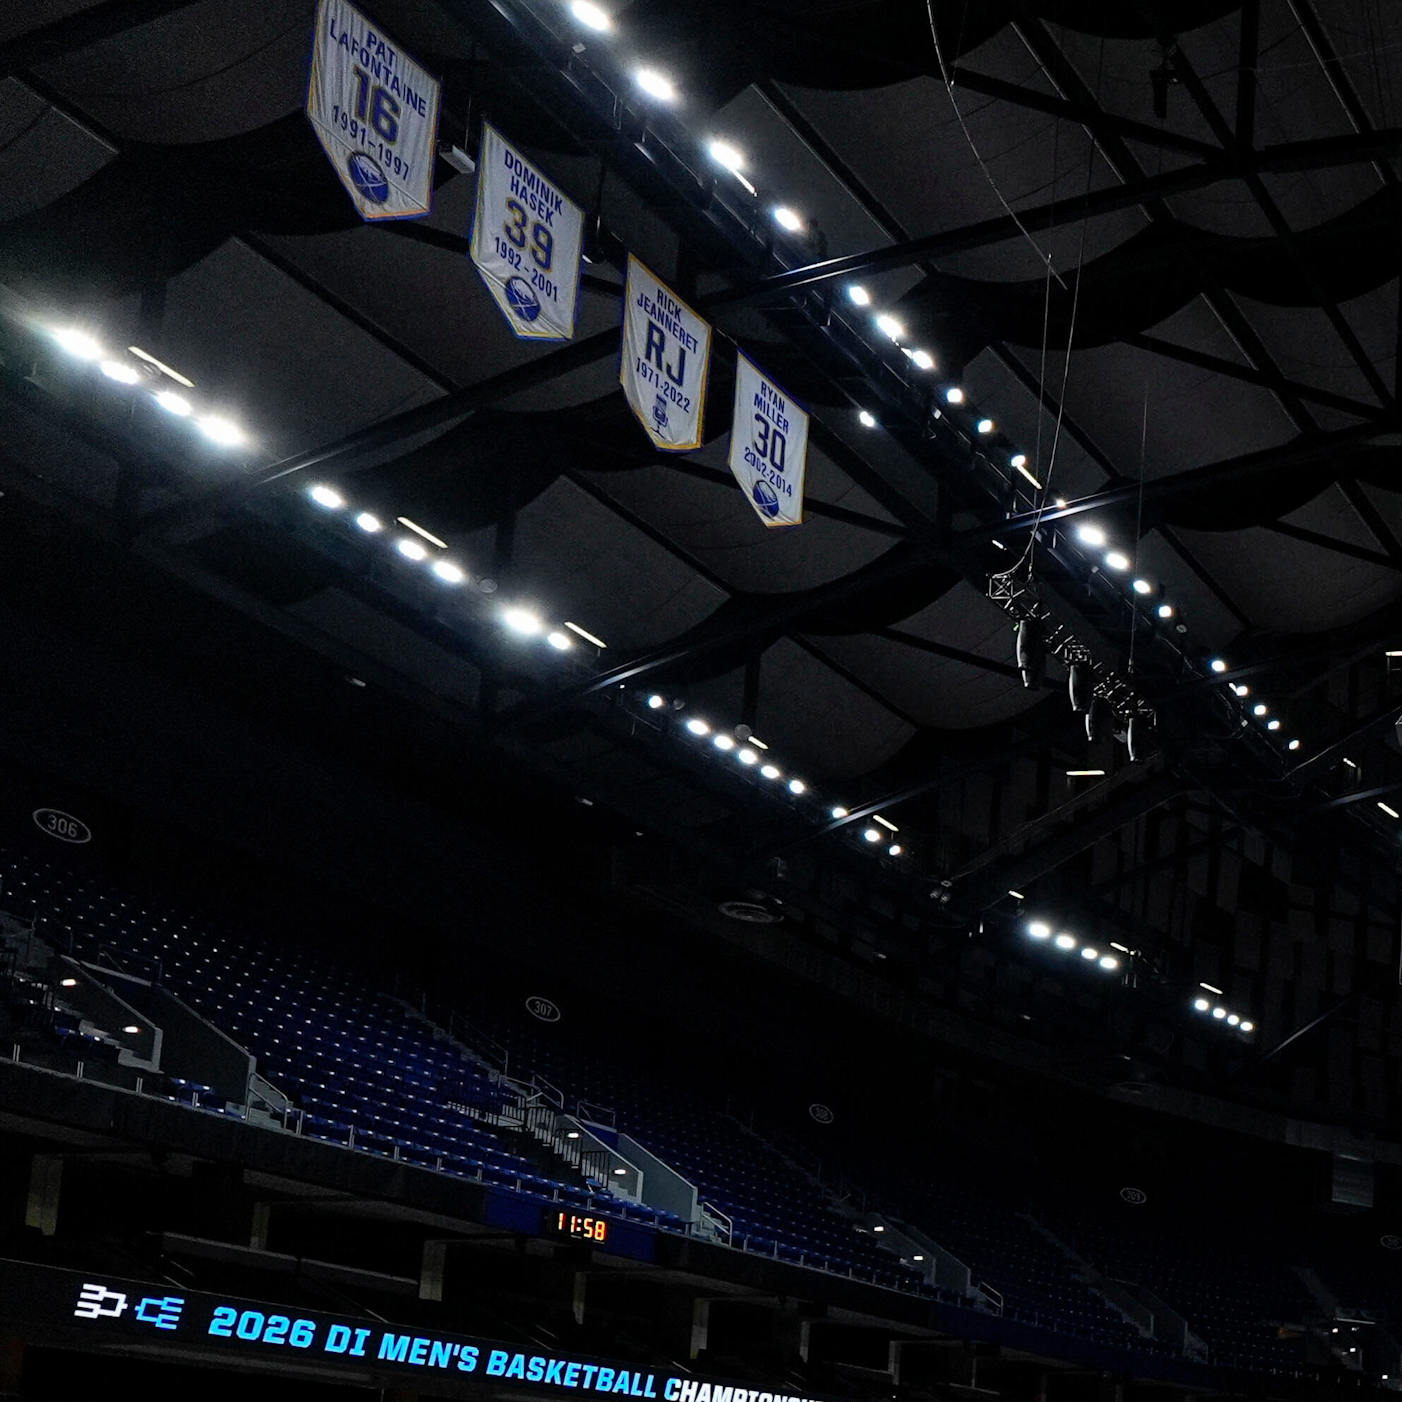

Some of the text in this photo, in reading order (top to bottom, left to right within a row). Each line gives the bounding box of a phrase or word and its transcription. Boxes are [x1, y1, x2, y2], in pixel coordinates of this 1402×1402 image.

[330, 18, 427, 118] LAFONTAINE
[368, 31, 396, 67] PAT
[353, 64, 402, 145] 16
[504, 149, 563, 215] DOMINIK
[511, 175, 553, 227] HASEK
[504, 197, 553, 273] 39
[637, 293, 699, 354] JEANNERET
[657, 289, 682, 322] RICK
[645, 320, 687, 387] RJ
[636, 357, 691, 414] 1971-2022
[753, 393, 789, 434] MILLER
[760, 381, 785, 414] RYAN
[744, 447, 792, 497] 2002-2014
[754, 413, 787, 473] 30
[558, 1212, 607, 1241] 11:58
[208, 1306, 316, 1348] 2026
[325, 1324, 371, 1357] DI
[378, 1332, 478, 1373] MEN'S
[485, 1350, 656, 1398] BASKETBALL
